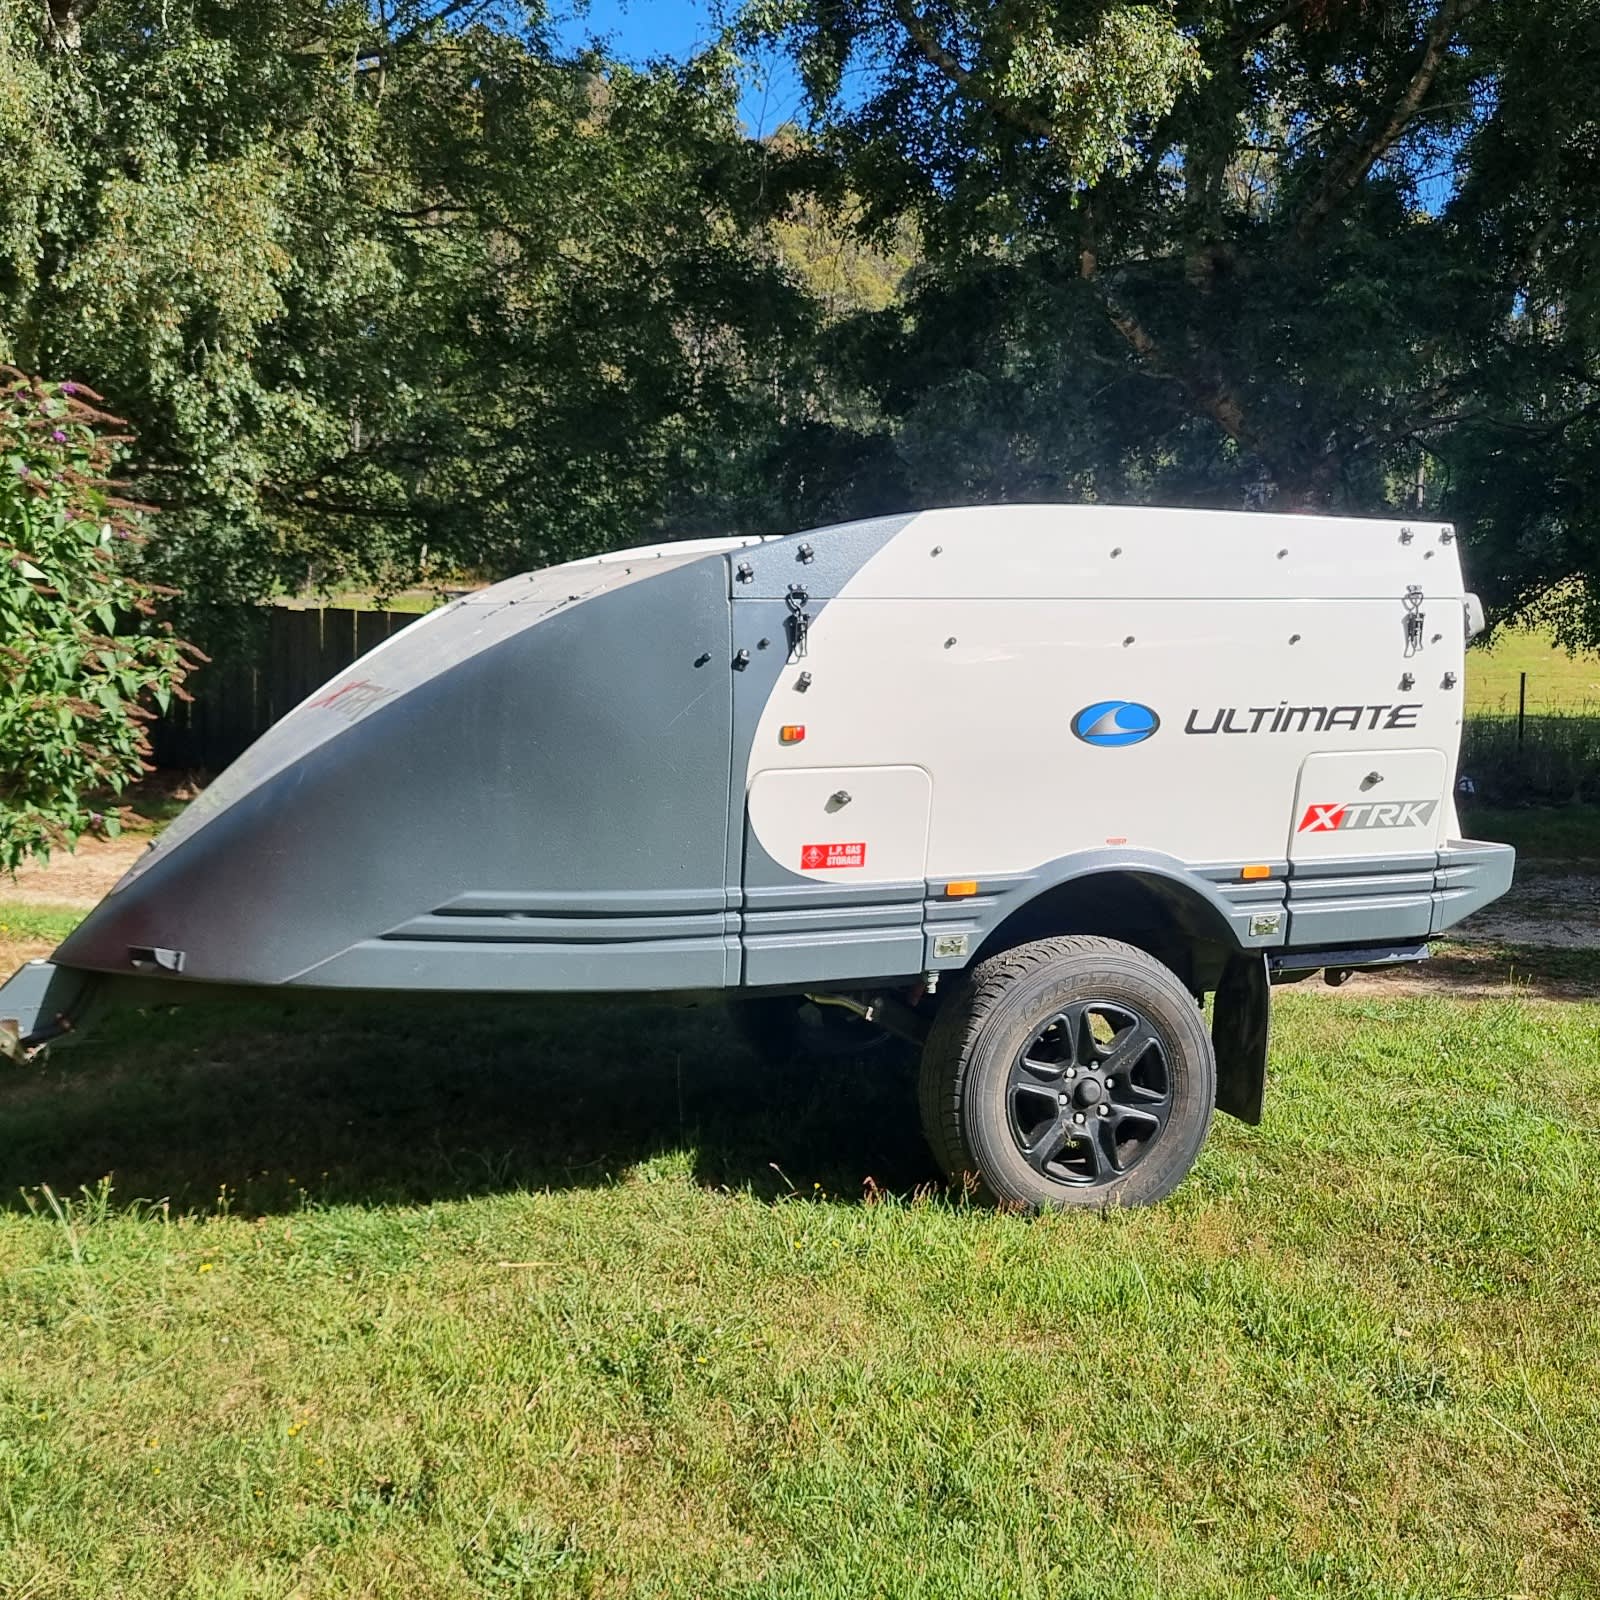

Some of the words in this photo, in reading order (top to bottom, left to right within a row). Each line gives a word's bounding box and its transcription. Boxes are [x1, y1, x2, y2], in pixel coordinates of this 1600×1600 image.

[1299, 801, 1428, 832] XTRK
[845, 844, 862, 855] GAS
[826, 855, 862, 866] STORAGE
